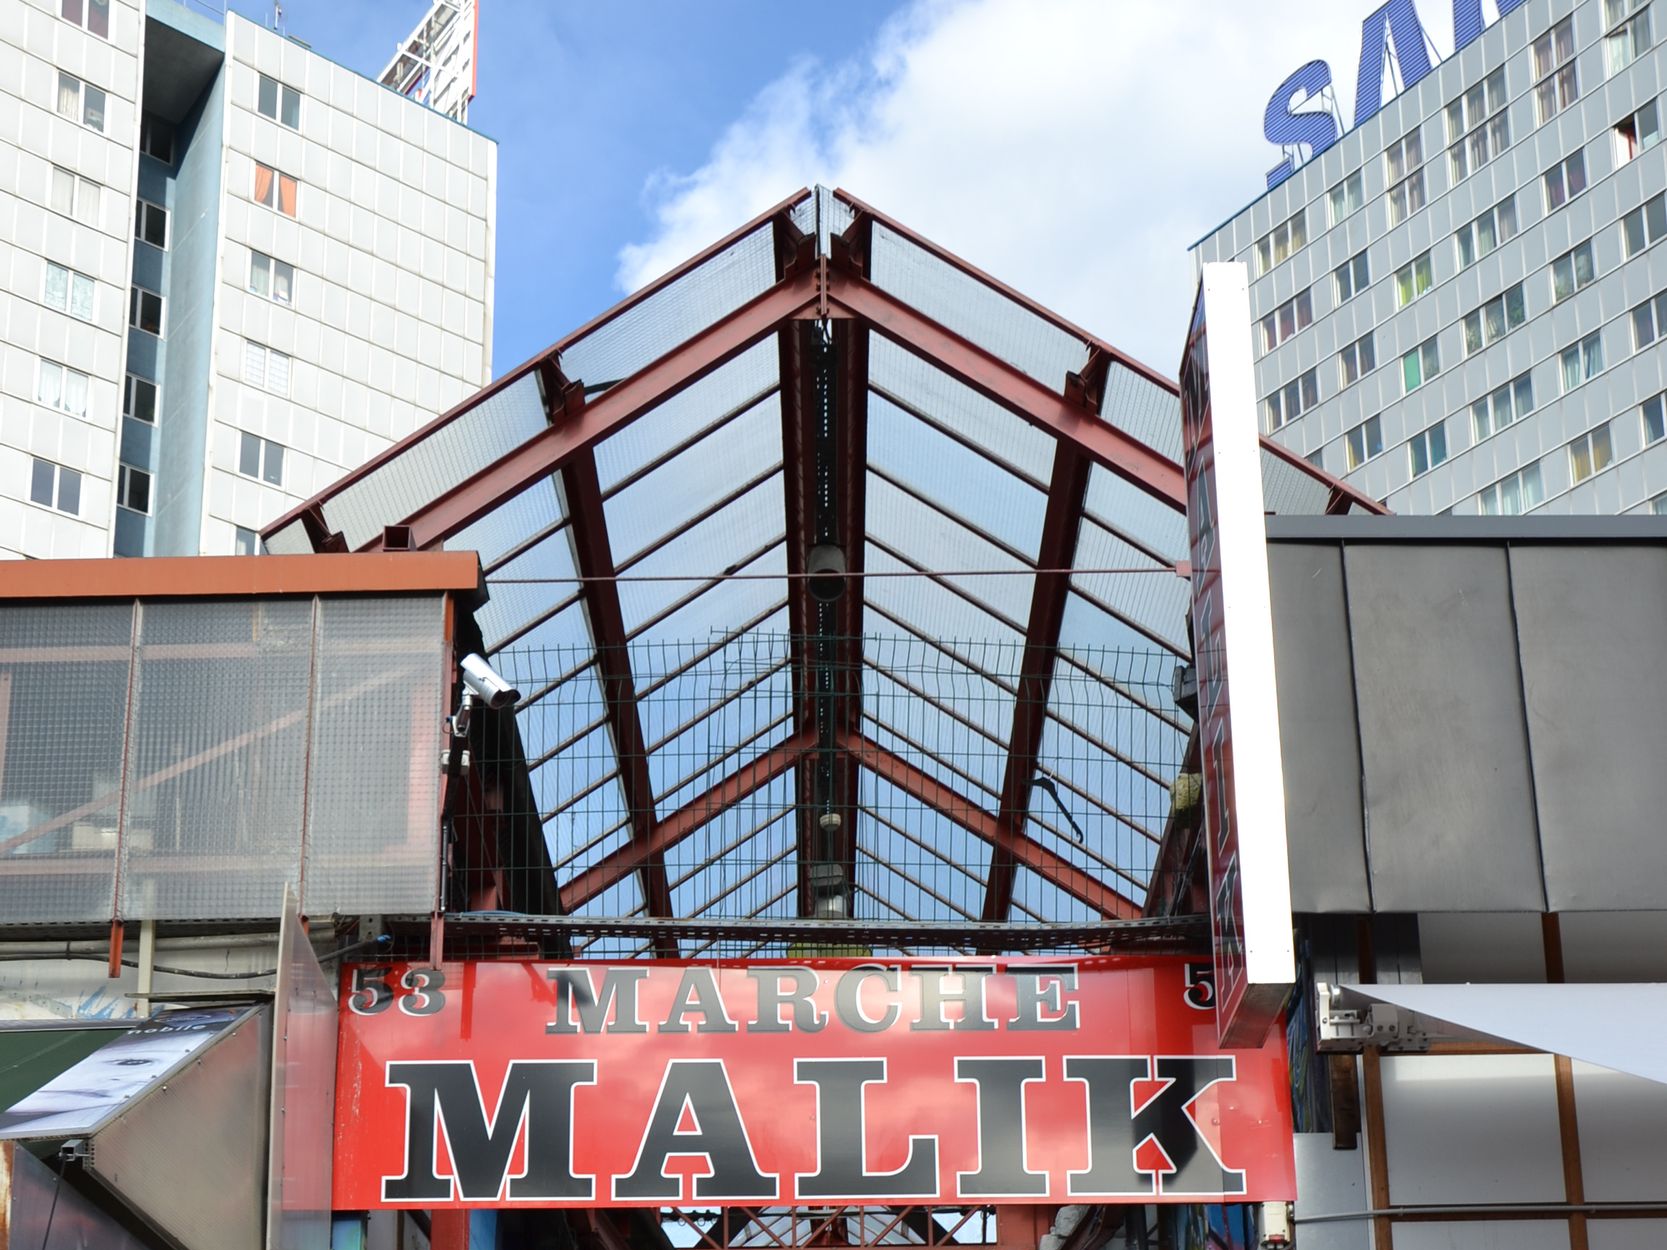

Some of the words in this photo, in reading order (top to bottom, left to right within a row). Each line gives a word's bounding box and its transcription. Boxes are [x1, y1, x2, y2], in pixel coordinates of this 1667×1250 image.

[1264, 0, 1527, 190] SA
[348, 966, 446, 1017] 53
[545, 963, 1081, 1035] MARCHE
[381, 1056, 1247, 1202] MALIK
